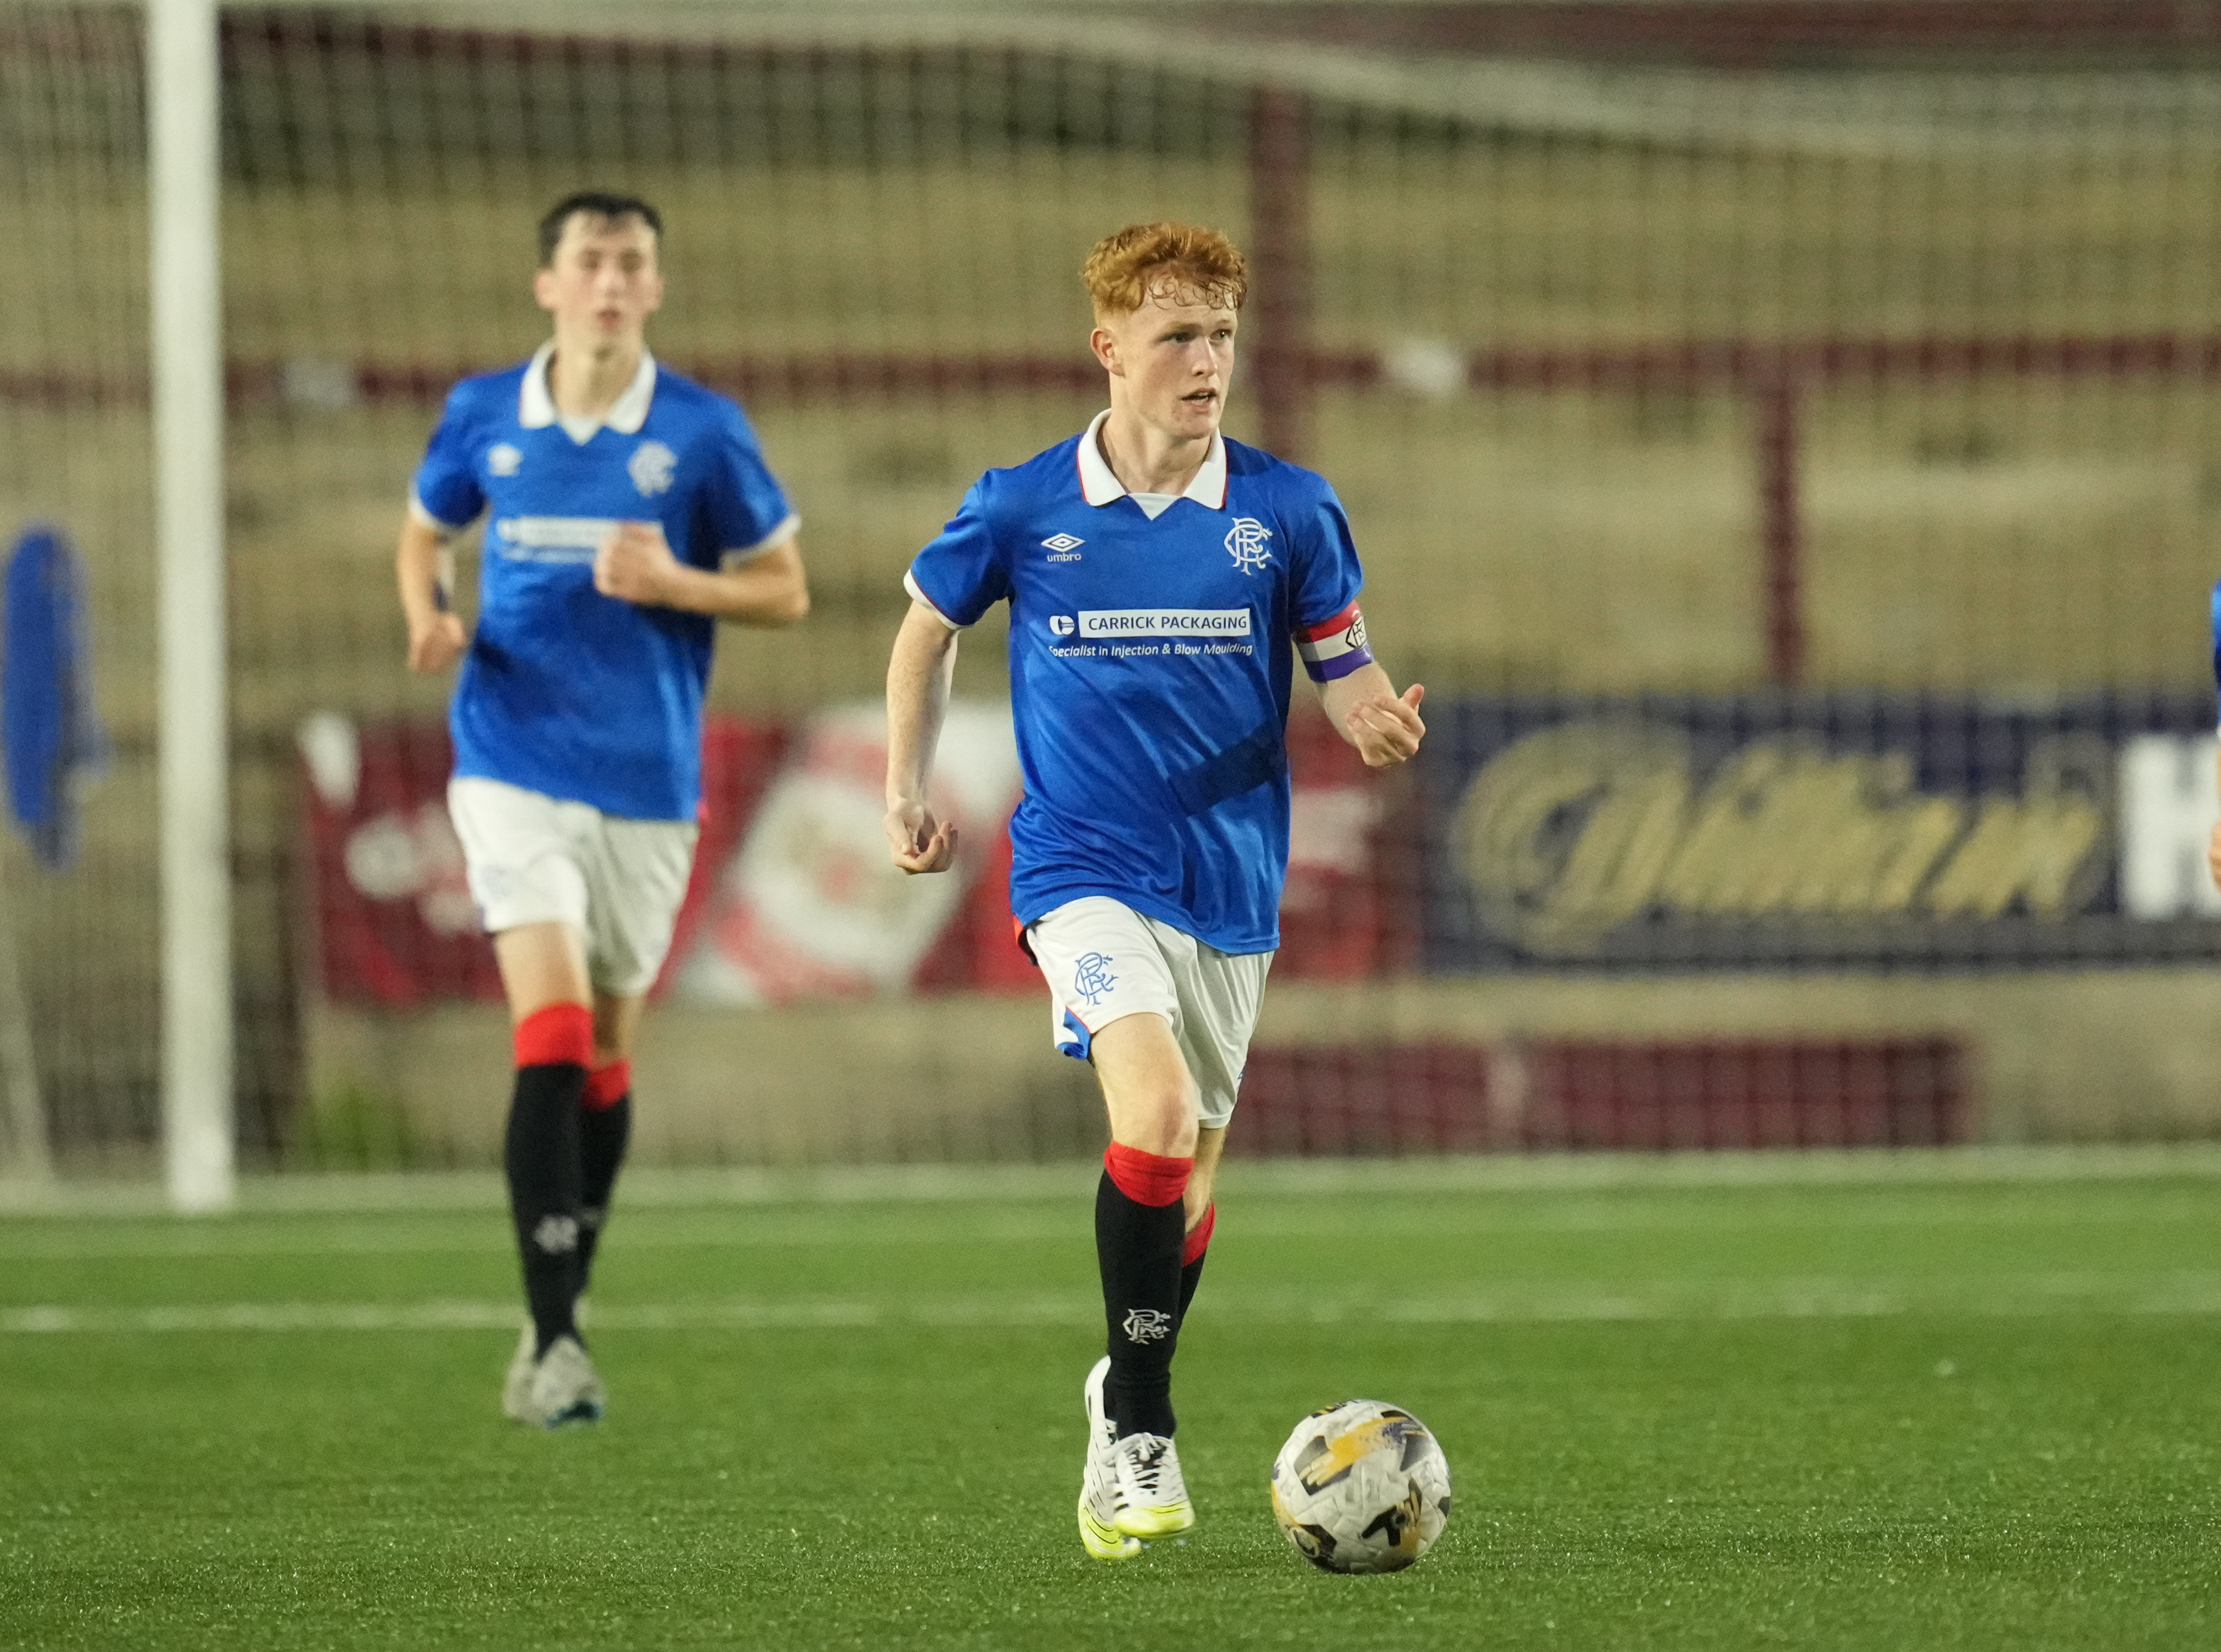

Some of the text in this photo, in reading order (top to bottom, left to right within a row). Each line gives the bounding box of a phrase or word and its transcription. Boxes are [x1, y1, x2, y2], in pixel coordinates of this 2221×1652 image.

[1047, 553, 1082, 562] umbro
[1088, 616, 1247, 630] CARRICK PACKAGING
[1099, 645, 1108, 657] in
[1112, 644, 1159, 659] Injection
[1162, 643, 1171, 655] &
[1174, 644, 1201, 655] Blow
[1203, 642, 1253, 657] Moulding
